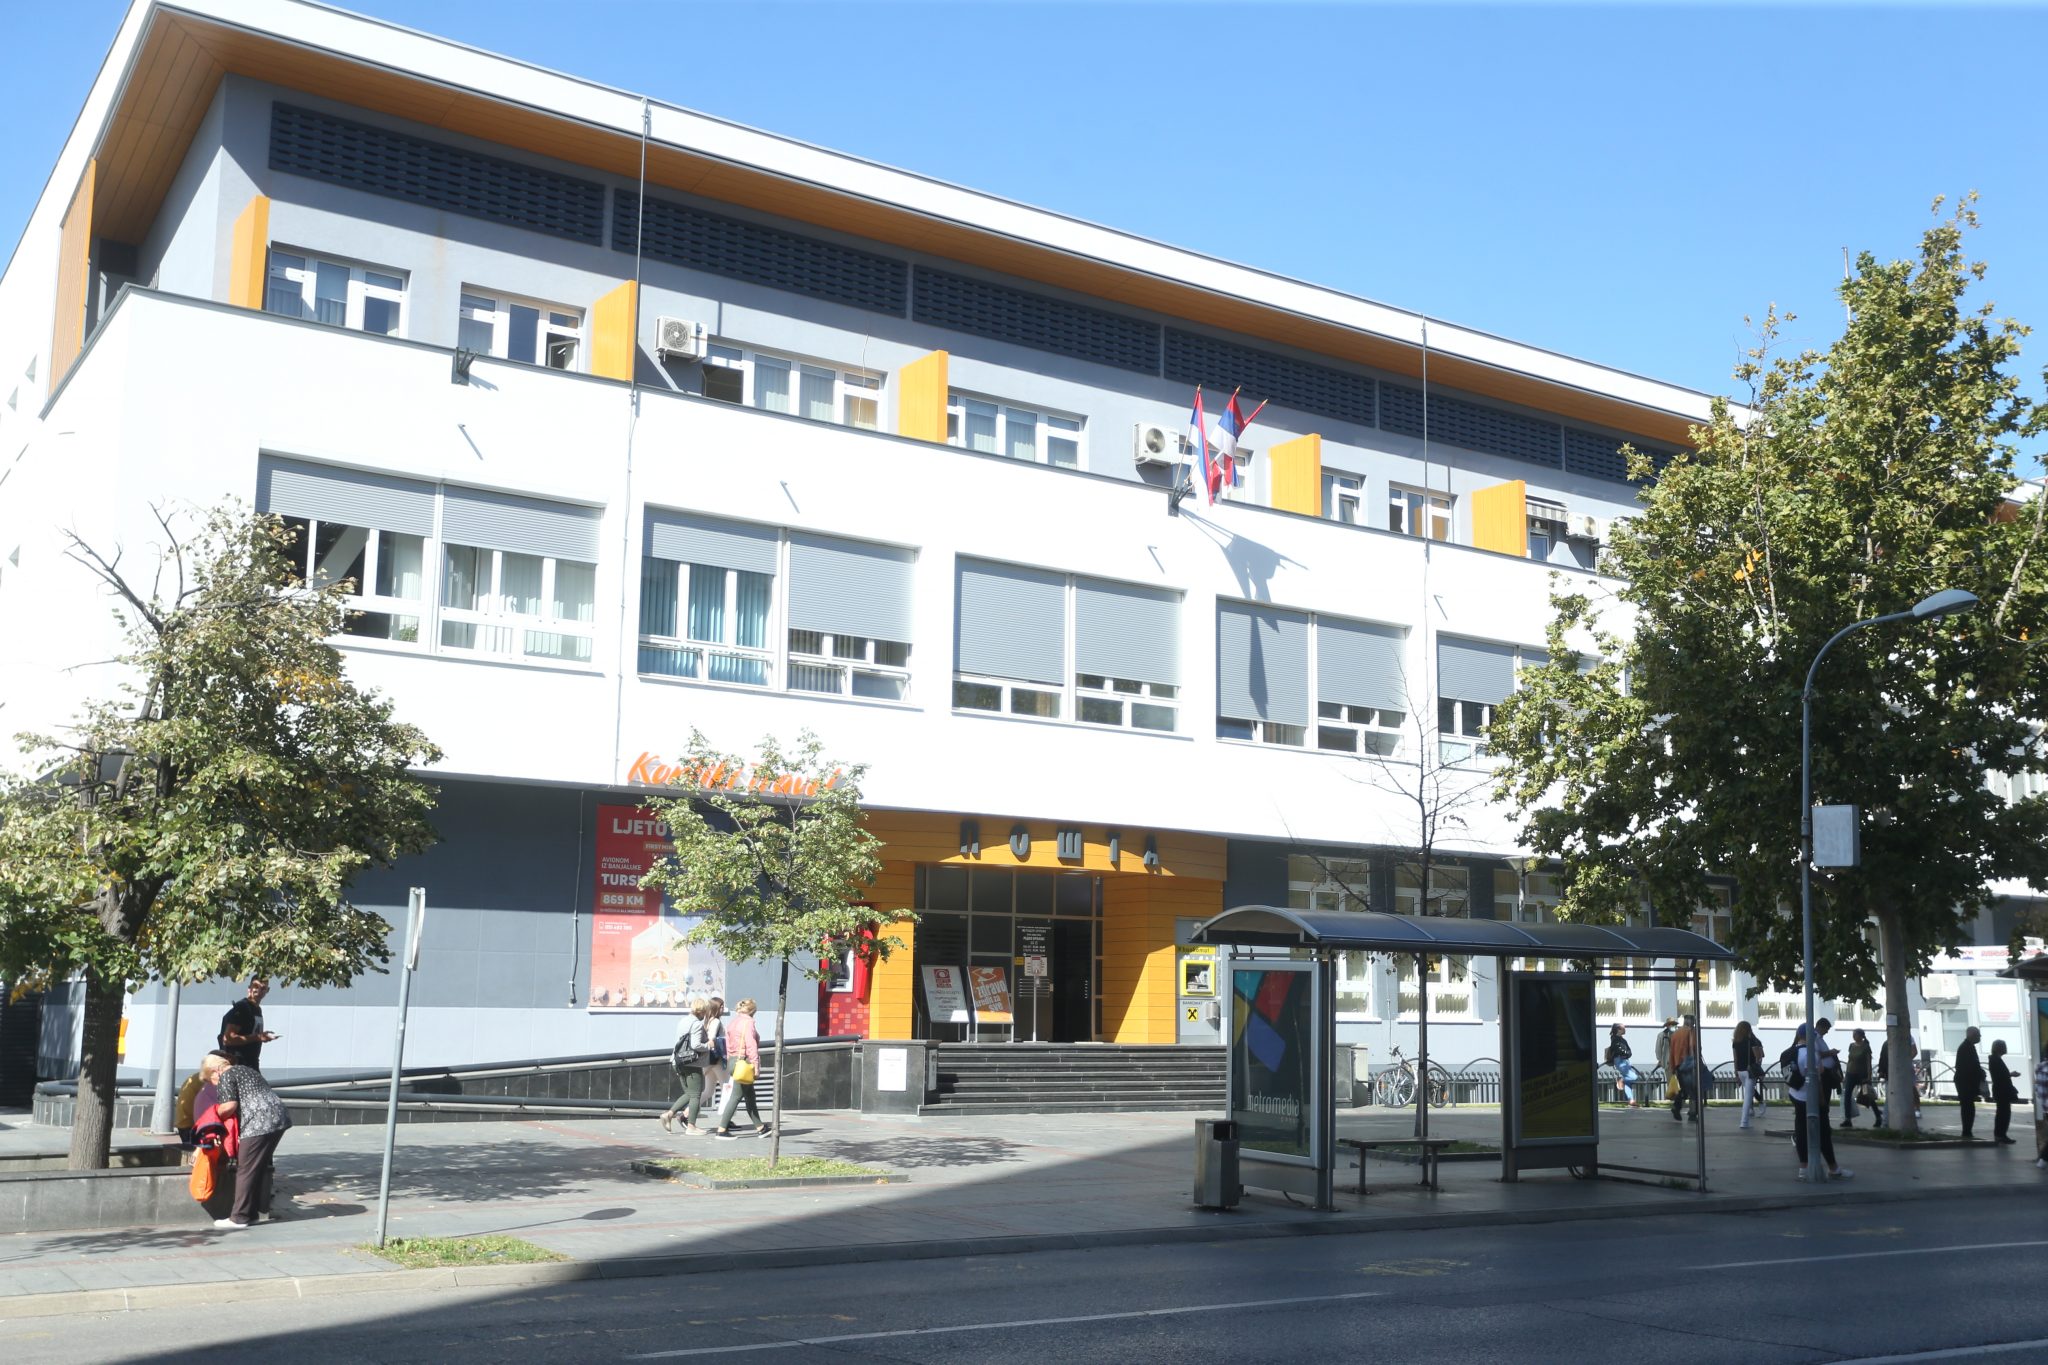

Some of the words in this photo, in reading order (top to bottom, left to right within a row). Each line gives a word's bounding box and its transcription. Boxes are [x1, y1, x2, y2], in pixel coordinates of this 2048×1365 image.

[612, 818, 668, 837] LJETO
[960, 818, 1159, 865] ПОШТА
[603, 894, 624, 905] 869
[626, 895, 644, 906] KM
[975, 980, 1007, 998] zdravo
[1247, 1090, 1300, 1117] metromedia
